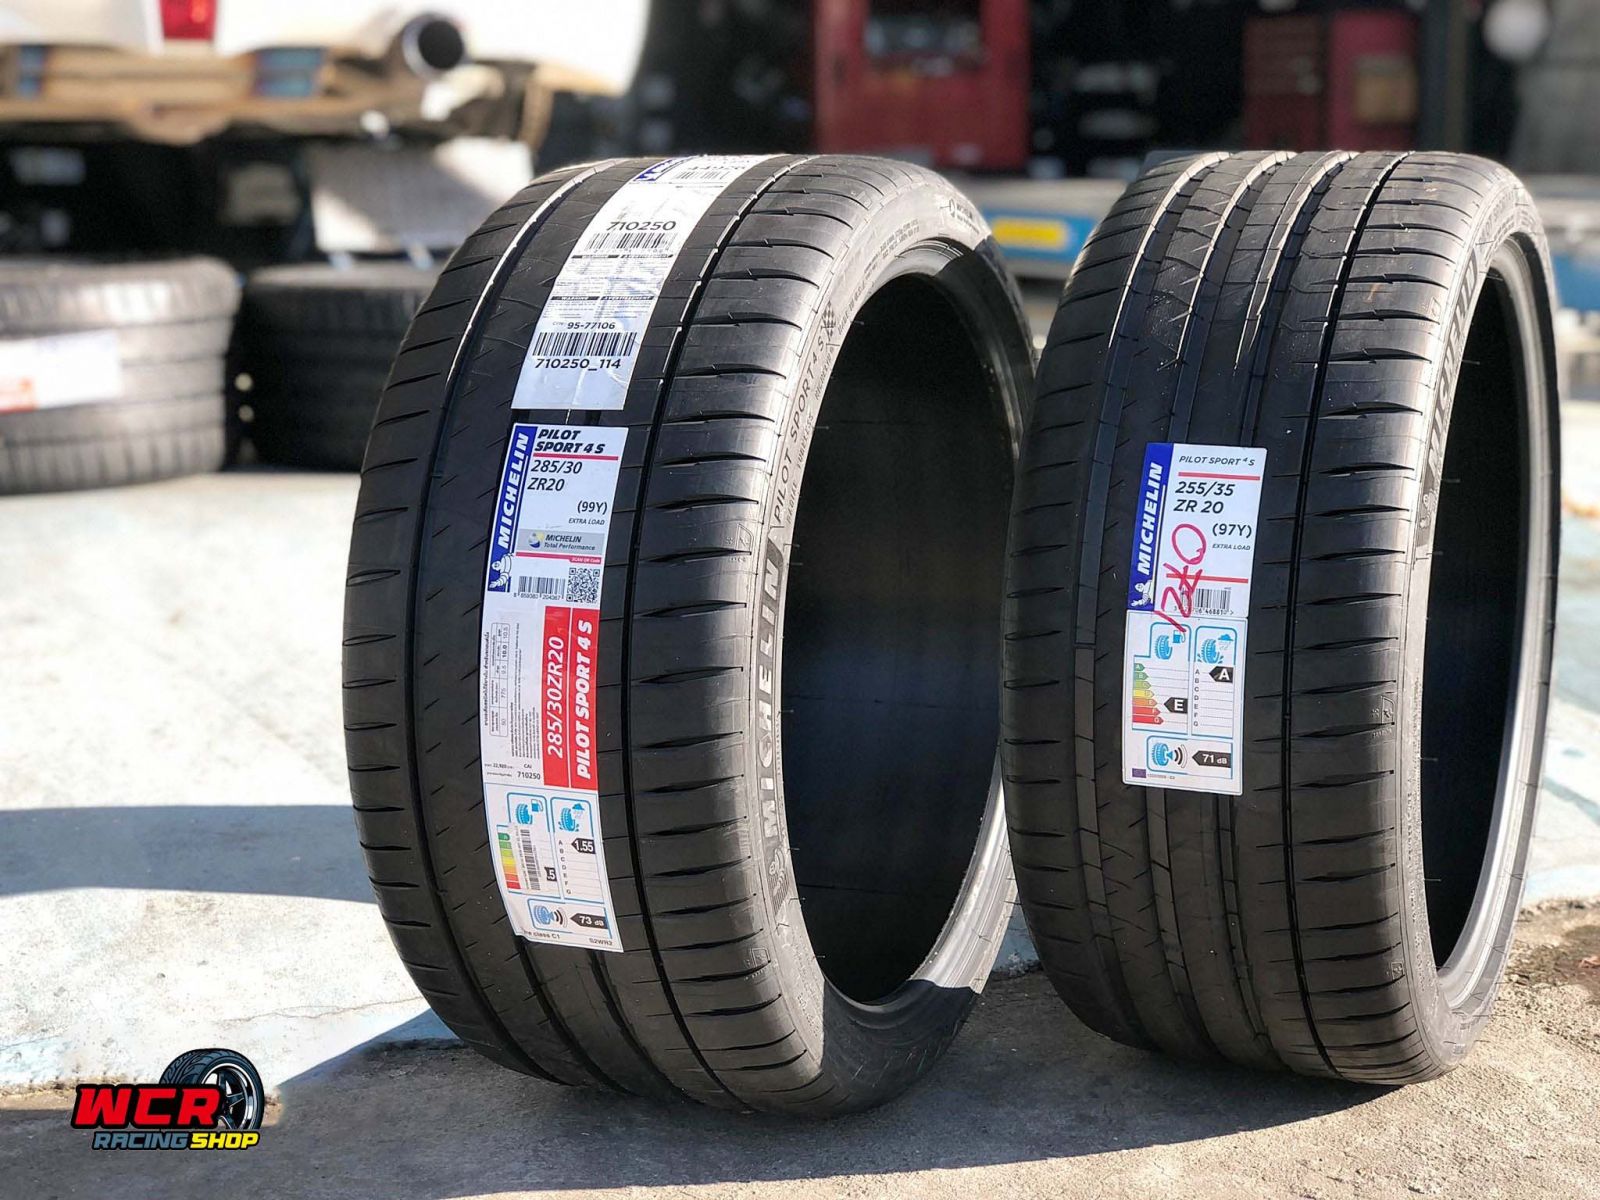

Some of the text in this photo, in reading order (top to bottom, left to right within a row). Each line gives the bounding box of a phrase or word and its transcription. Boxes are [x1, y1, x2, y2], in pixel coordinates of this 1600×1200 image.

[606, 221, 676, 231] 710250
[567, 322, 615, 330] 95-77106
[535, 358, 621, 371] 710250_114
[537, 428, 581, 440] PILOT
[534, 440, 584, 453] SPORT
[774, 447, 792, 523] PILOT
[790, 362, 814, 443] SPORT
[530, 459, 582, 474] 285/30
[1178, 455, 1209, 465] PILOT
[1209, 456, 1240, 466] SPORT
[497, 432, 529, 549] MICHELIN
[527, 477, 565, 492] ZR20
[1174, 481, 1235, 497] 255/35
[576, 500, 608, 515] (99Y)
[568, 517, 587, 525] EXTRA
[1136, 462, 1164, 576] MICHELIN
[1212, 523, 1252, 539] (97Y)
[544, 533, 582, 543] MICHELIN
[543, 541, 596, 551] Total Performance
[1218, 668, 1230, 681] A
[574, 651, 591, 720] SPORT
[546, 635, 564, 759] 285/30ZR20
[759, 558, 779, 838] MICHELIN
[1174, 699, 1184, 711] E
[574, 720, 591, 780] PILOT
[1203, 754, 1215, 763] 71
[516, 771, 541, 780] 710250
[574, 840, 594, 852] 1.55
[579, 915, 592, 925] 73
